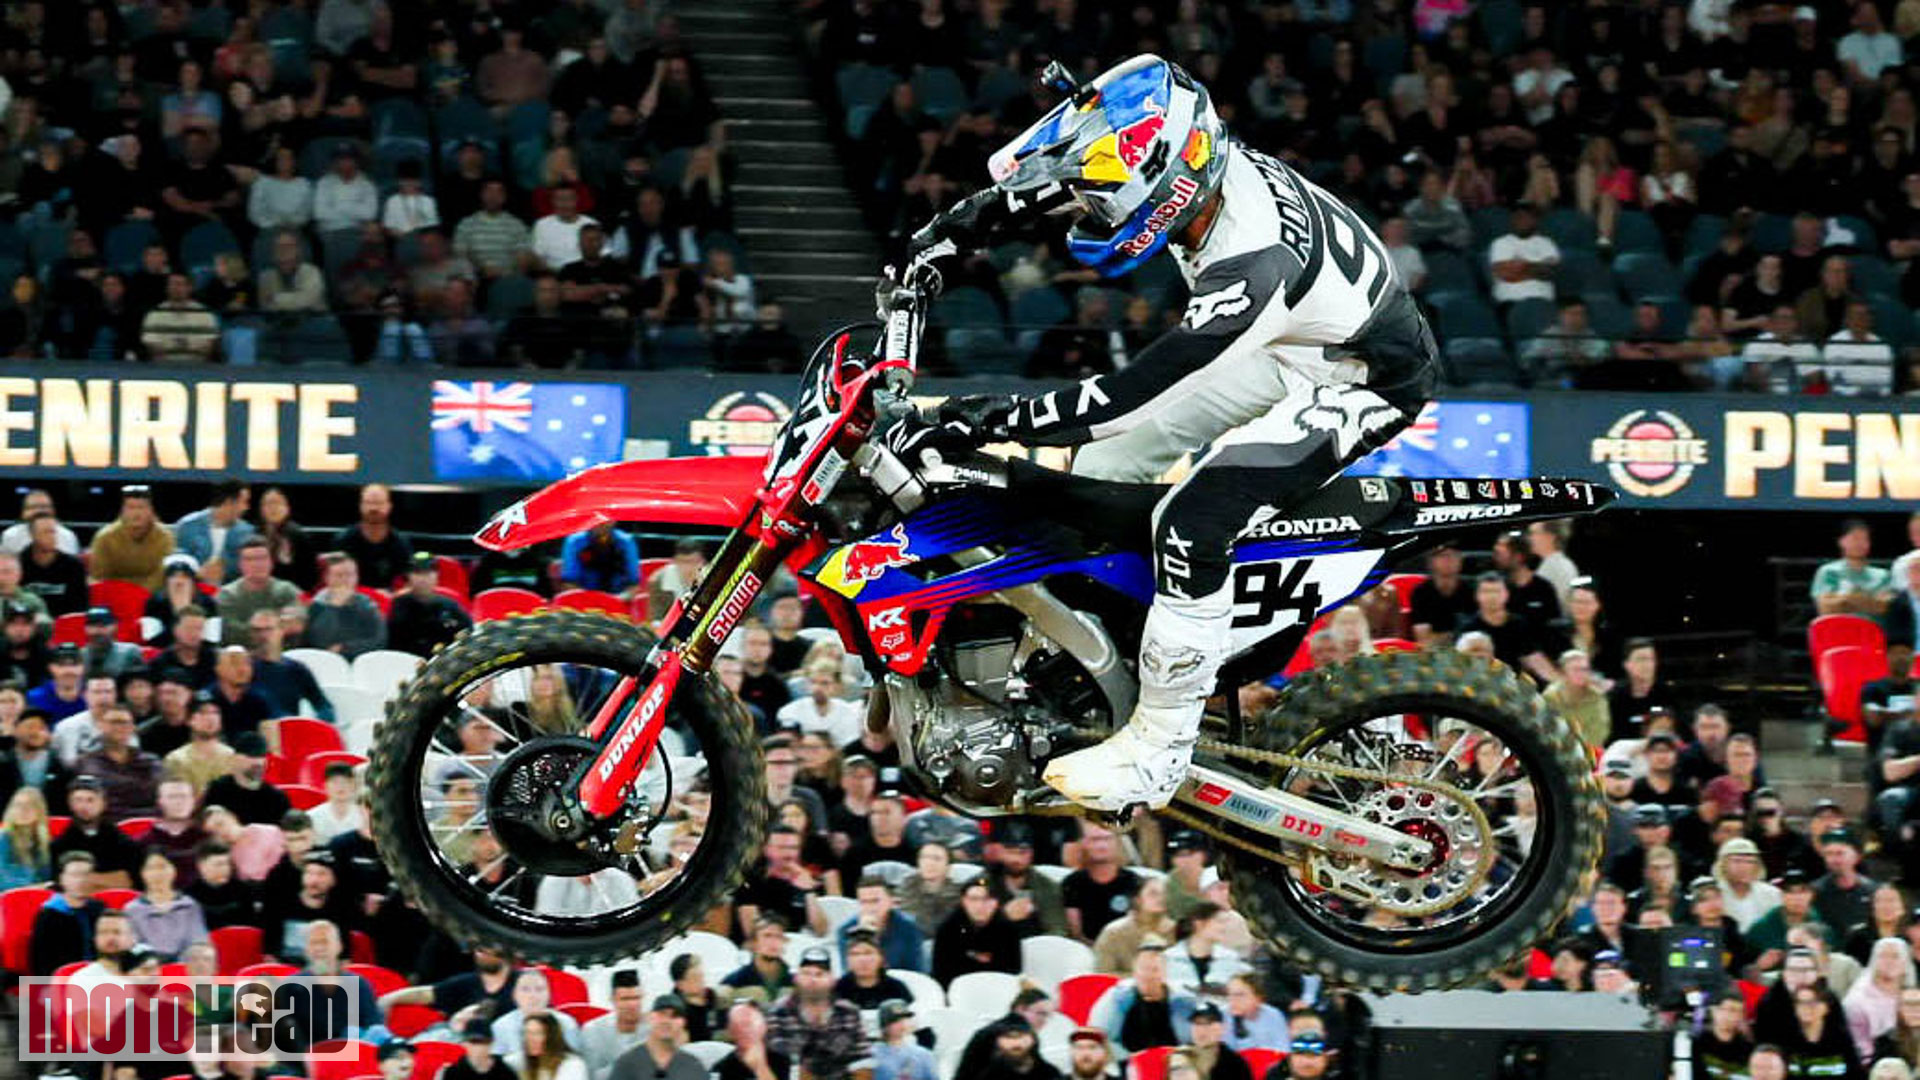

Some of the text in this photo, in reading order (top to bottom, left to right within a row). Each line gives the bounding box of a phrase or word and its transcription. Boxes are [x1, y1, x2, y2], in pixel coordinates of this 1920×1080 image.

[1246, 516, 1361, 538] HONDA
[1415, 504, 1521, 525] DUNLOP
[1163, 525, 1193, 600] FOX
[1230, 558, 1322, 628] 94
[707, 570, 762, 645] SHOWA
[599, 684, 665, 782] DUNLOP
